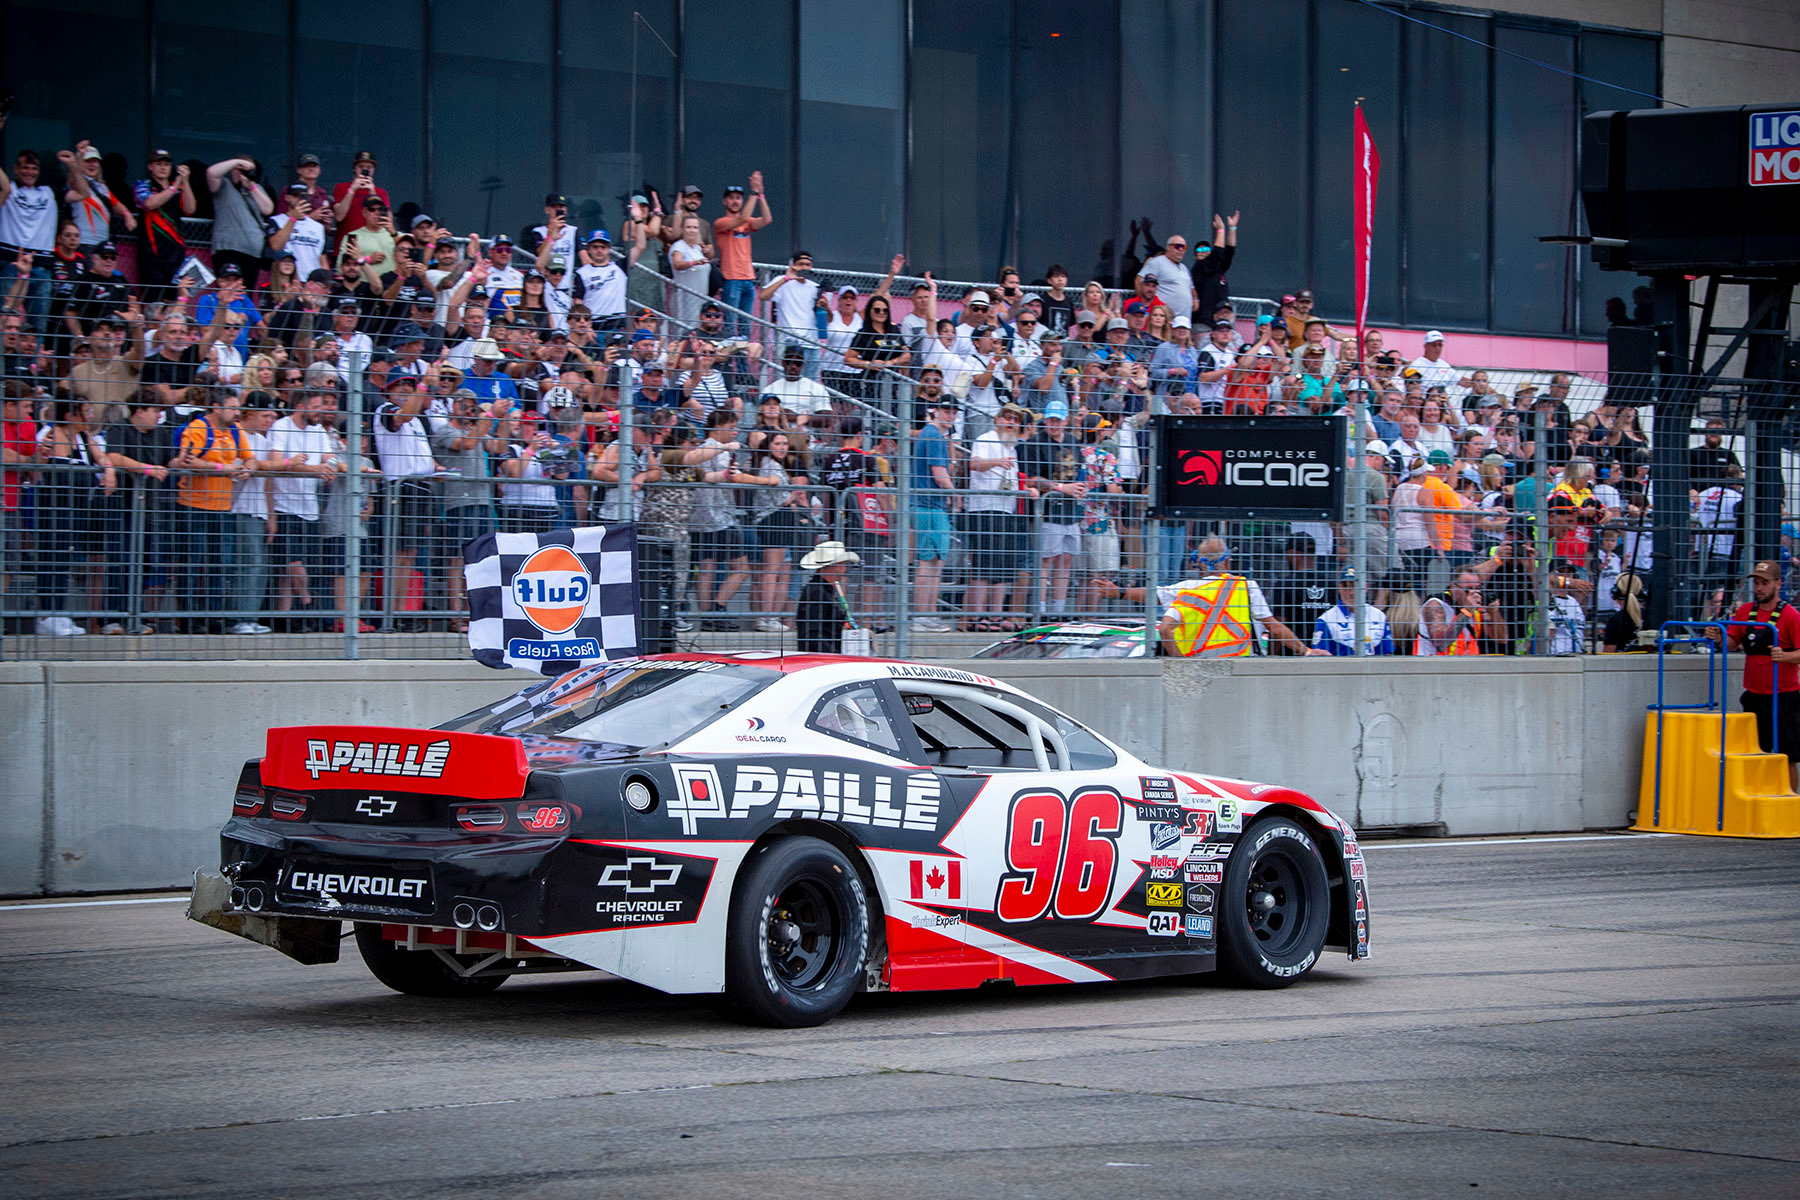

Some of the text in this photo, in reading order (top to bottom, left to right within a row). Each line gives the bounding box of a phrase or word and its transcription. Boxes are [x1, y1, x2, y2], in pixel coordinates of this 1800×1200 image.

[1225, 450, 1317, 458] COMPLEXE
[1225, 462, 1330, 487] ICAR
[911, 667, 974, 682] CAMIRAND
[331, 740, 450, 778] PAILLÉ
[532, 807, 562, 829] 96
[1138, 806, 1180, 818] PINTY'S
[1256, 826, 1313, 851] GENERAL
[994, 786, 1124, 923] 96
[1190, 843, 1234, 855] PFC
[1150, 855, 1178, 870] Holley
[1186, 864, 1216, 873] LINCOLN
[1151, 869, 1175, 879] MSD
[291, 872, 428, 898] CHEVROLET
[596, 901, 683, 912] CHEVROLET
[613, 914, 664, 922] RACING
[1150, 915, 1177, 933] QA1
